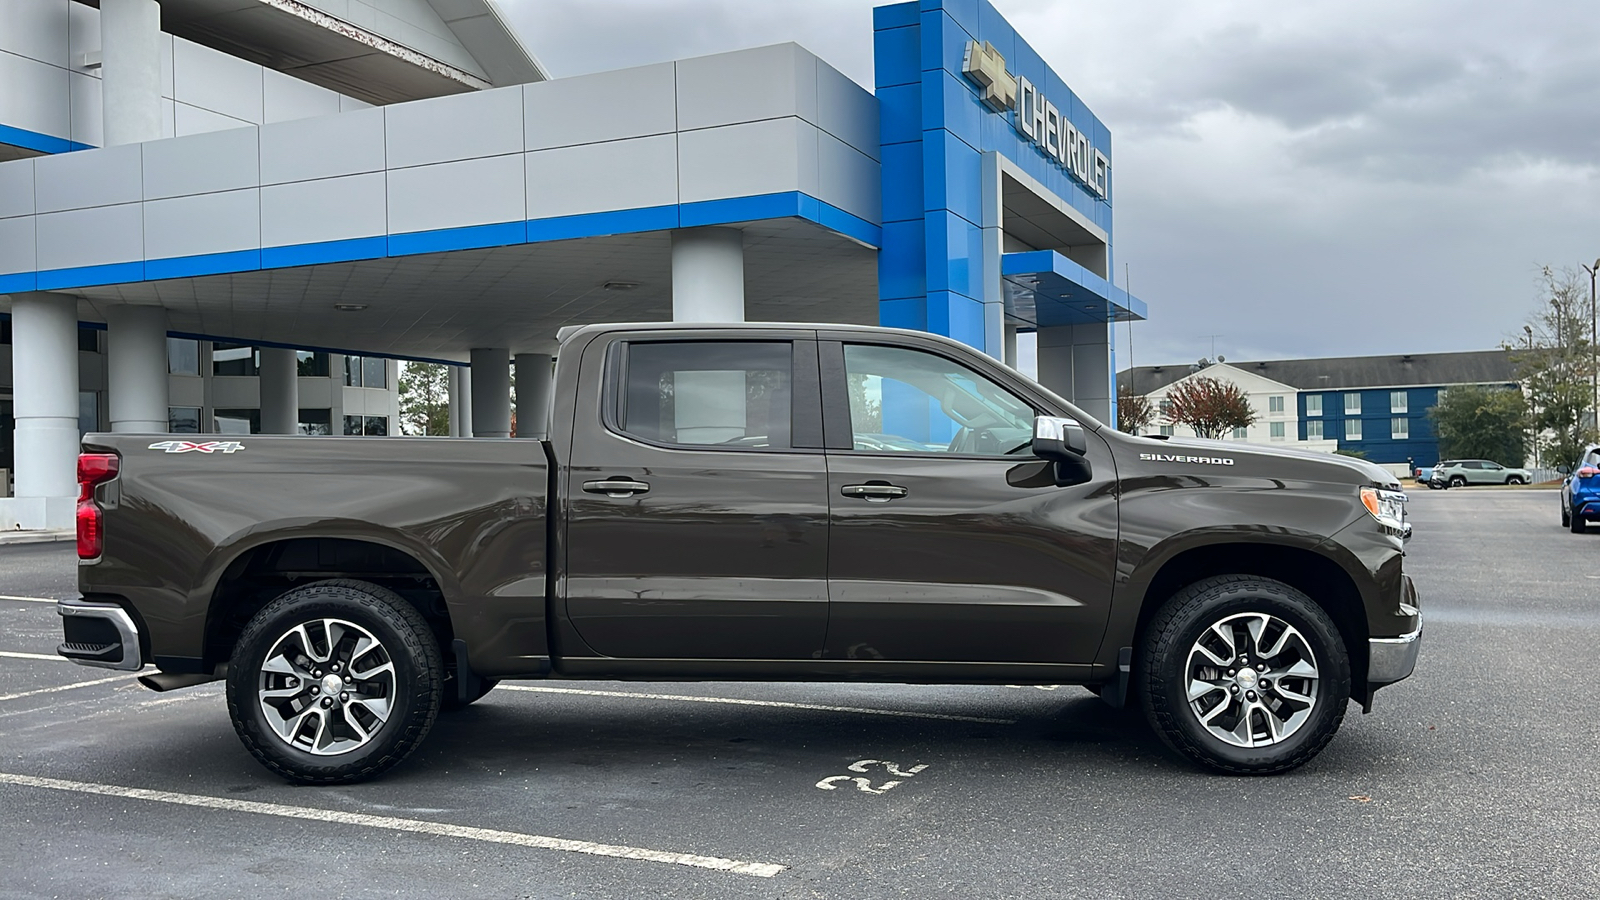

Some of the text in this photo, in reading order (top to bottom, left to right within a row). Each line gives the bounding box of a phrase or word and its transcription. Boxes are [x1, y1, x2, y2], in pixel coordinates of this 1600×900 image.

[1016, 75, 1109, 201] CHEVROLET
[1140, 453, 1234, 465] SILVERADO
[815, 759, 929, 794] 22
